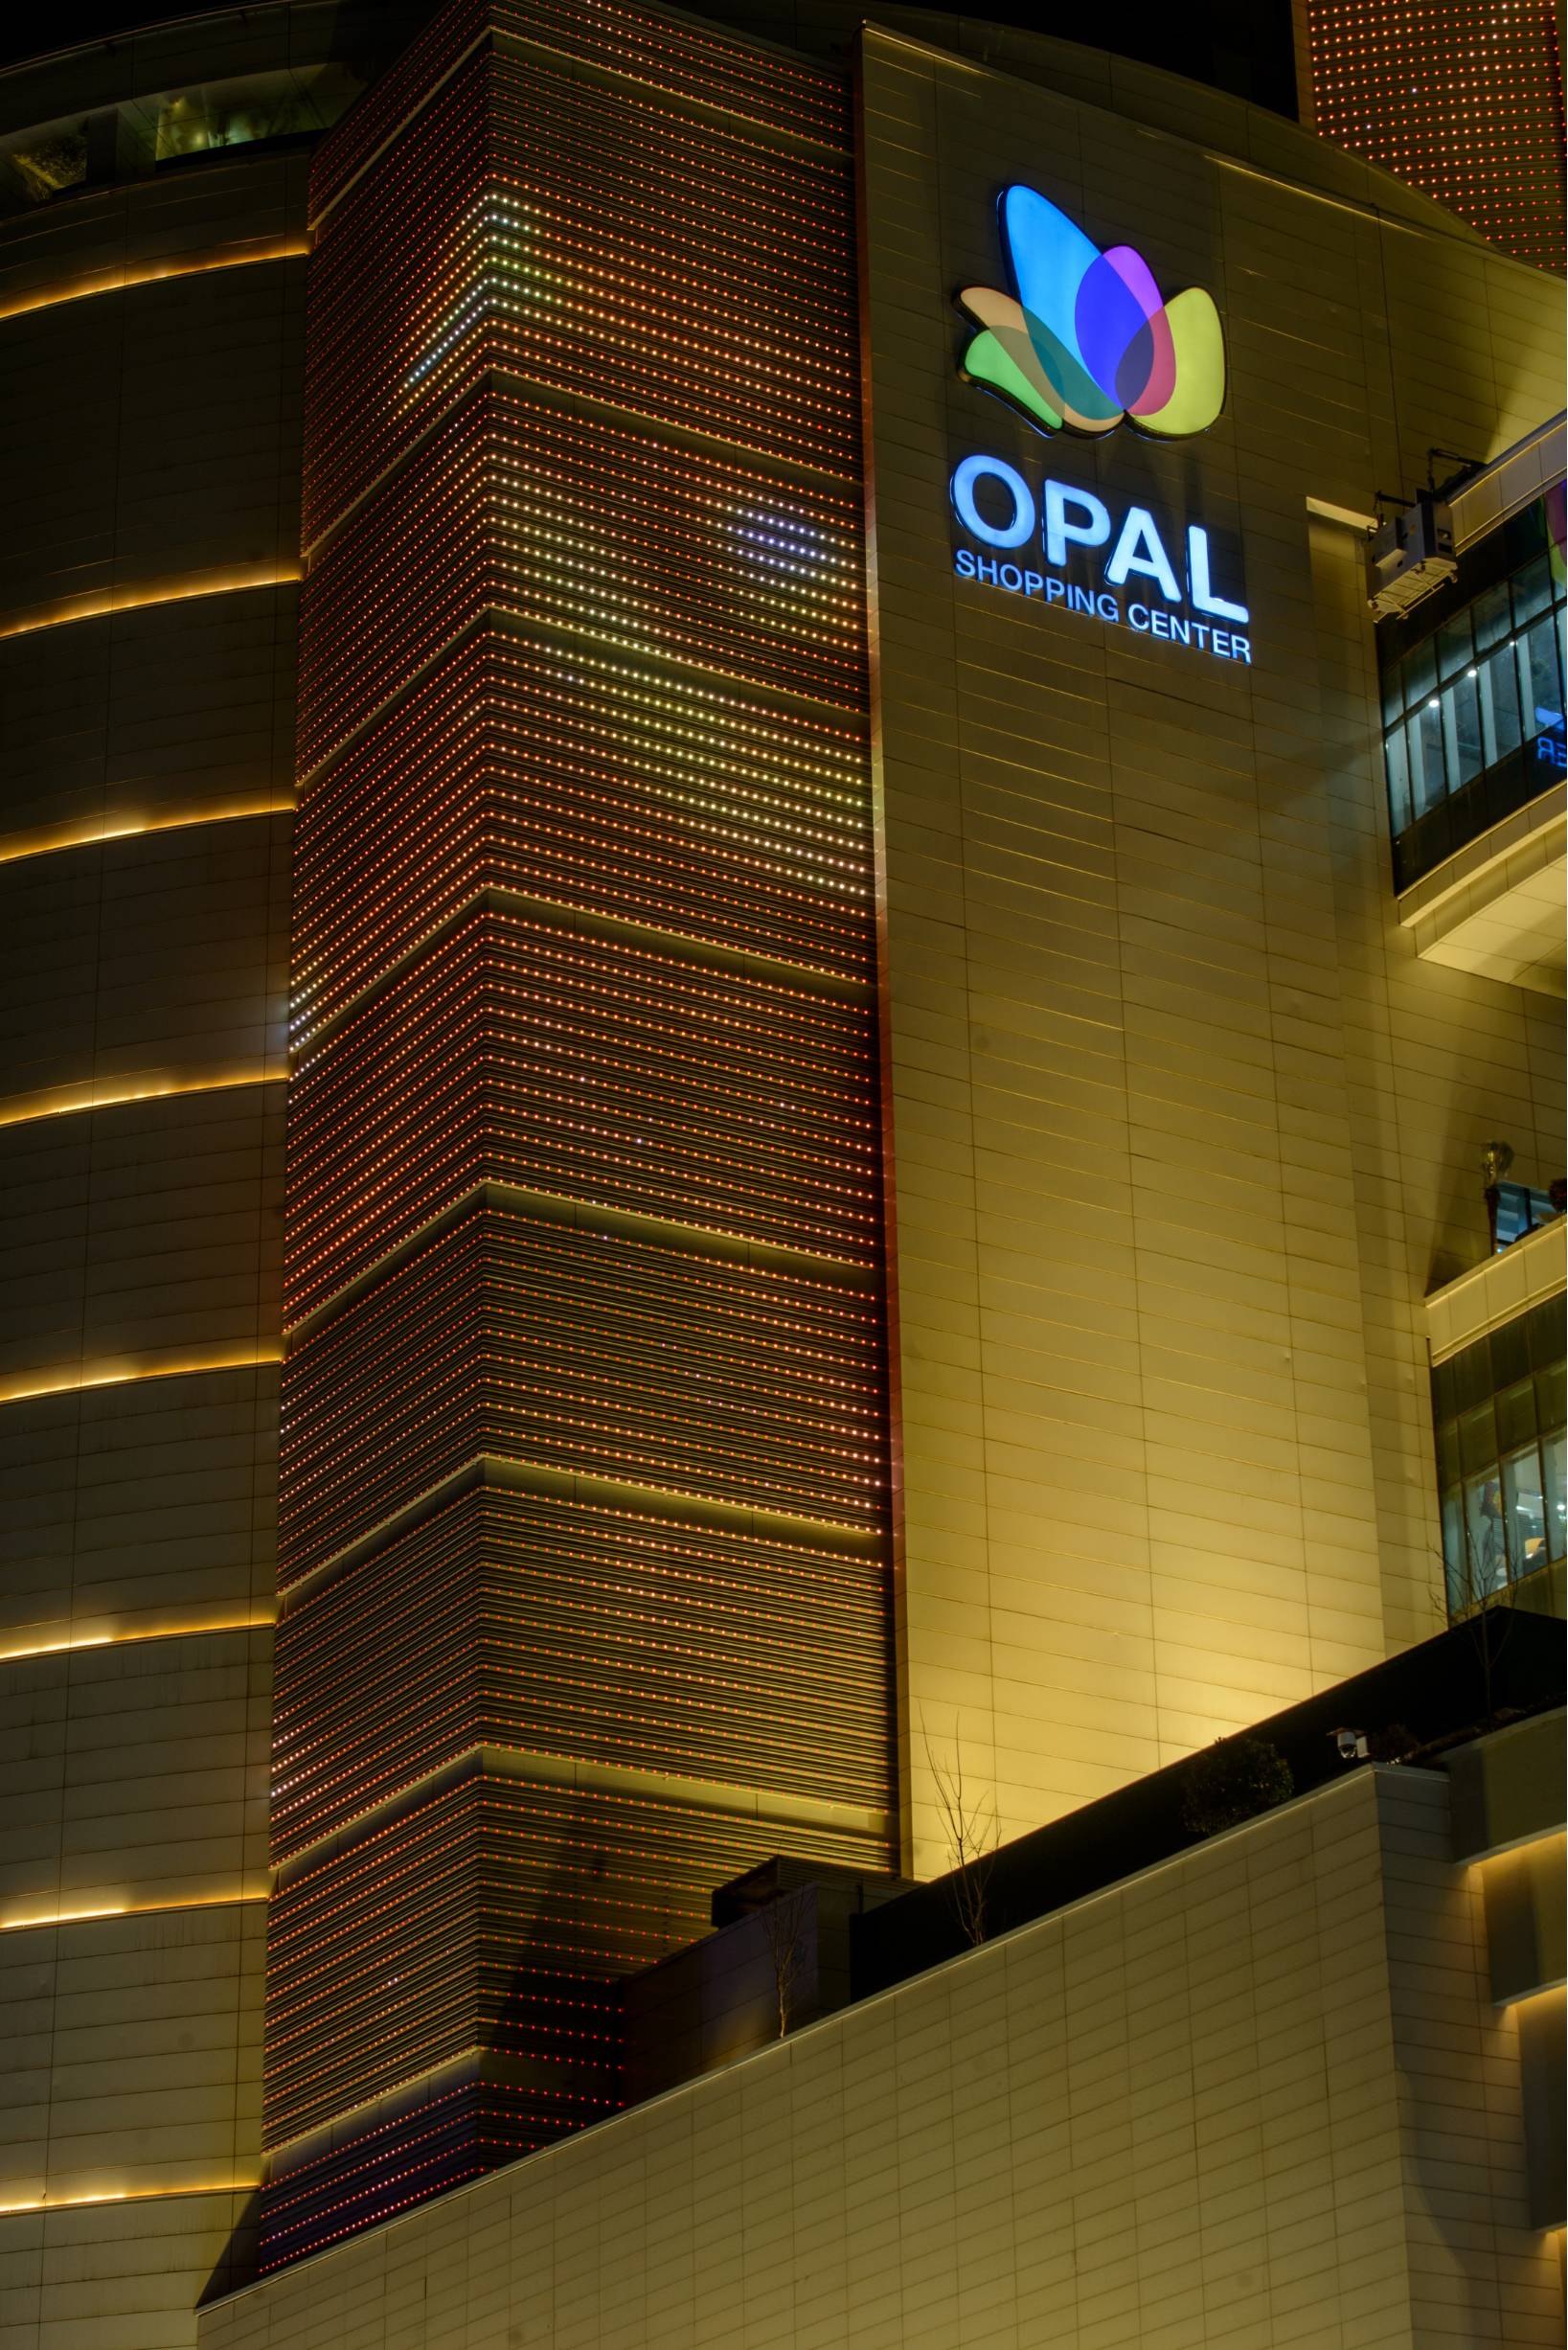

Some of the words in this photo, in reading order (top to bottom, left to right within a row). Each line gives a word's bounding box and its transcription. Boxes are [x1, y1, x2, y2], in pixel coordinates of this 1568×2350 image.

[950, 454, 1250, 624] OPAL
[955, 549, 1120, 623] SHOPPING
[1126, 604, 1252, 665] CENTER
